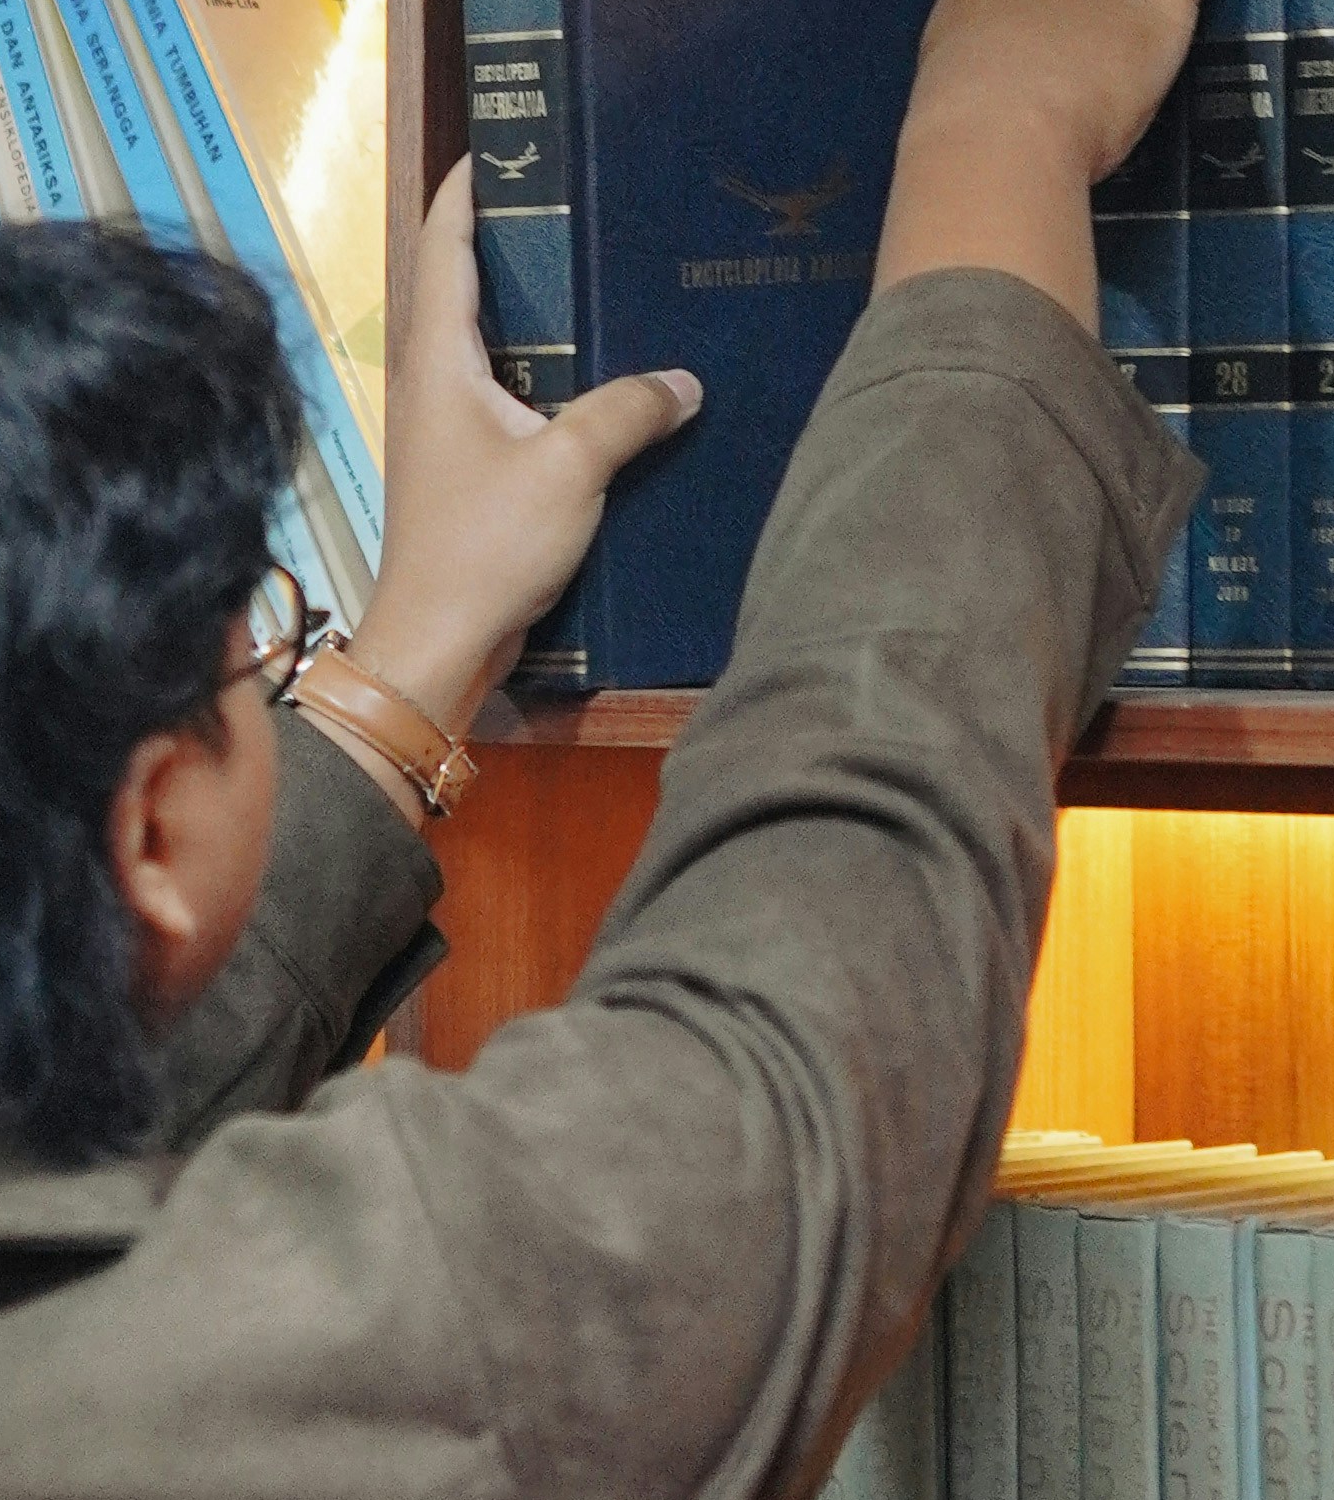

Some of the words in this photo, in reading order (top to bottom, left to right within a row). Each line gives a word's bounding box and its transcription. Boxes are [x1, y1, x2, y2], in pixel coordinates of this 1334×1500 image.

[1, 20, 25, 71] DAN
[18, 81, 63, 207] ANTARIKSA
[87, 34, 140, 151] SERANGGA
[166, 44, 223, 164] TUMBUHAN
[472, 89, 548, 121] AMERICANA
